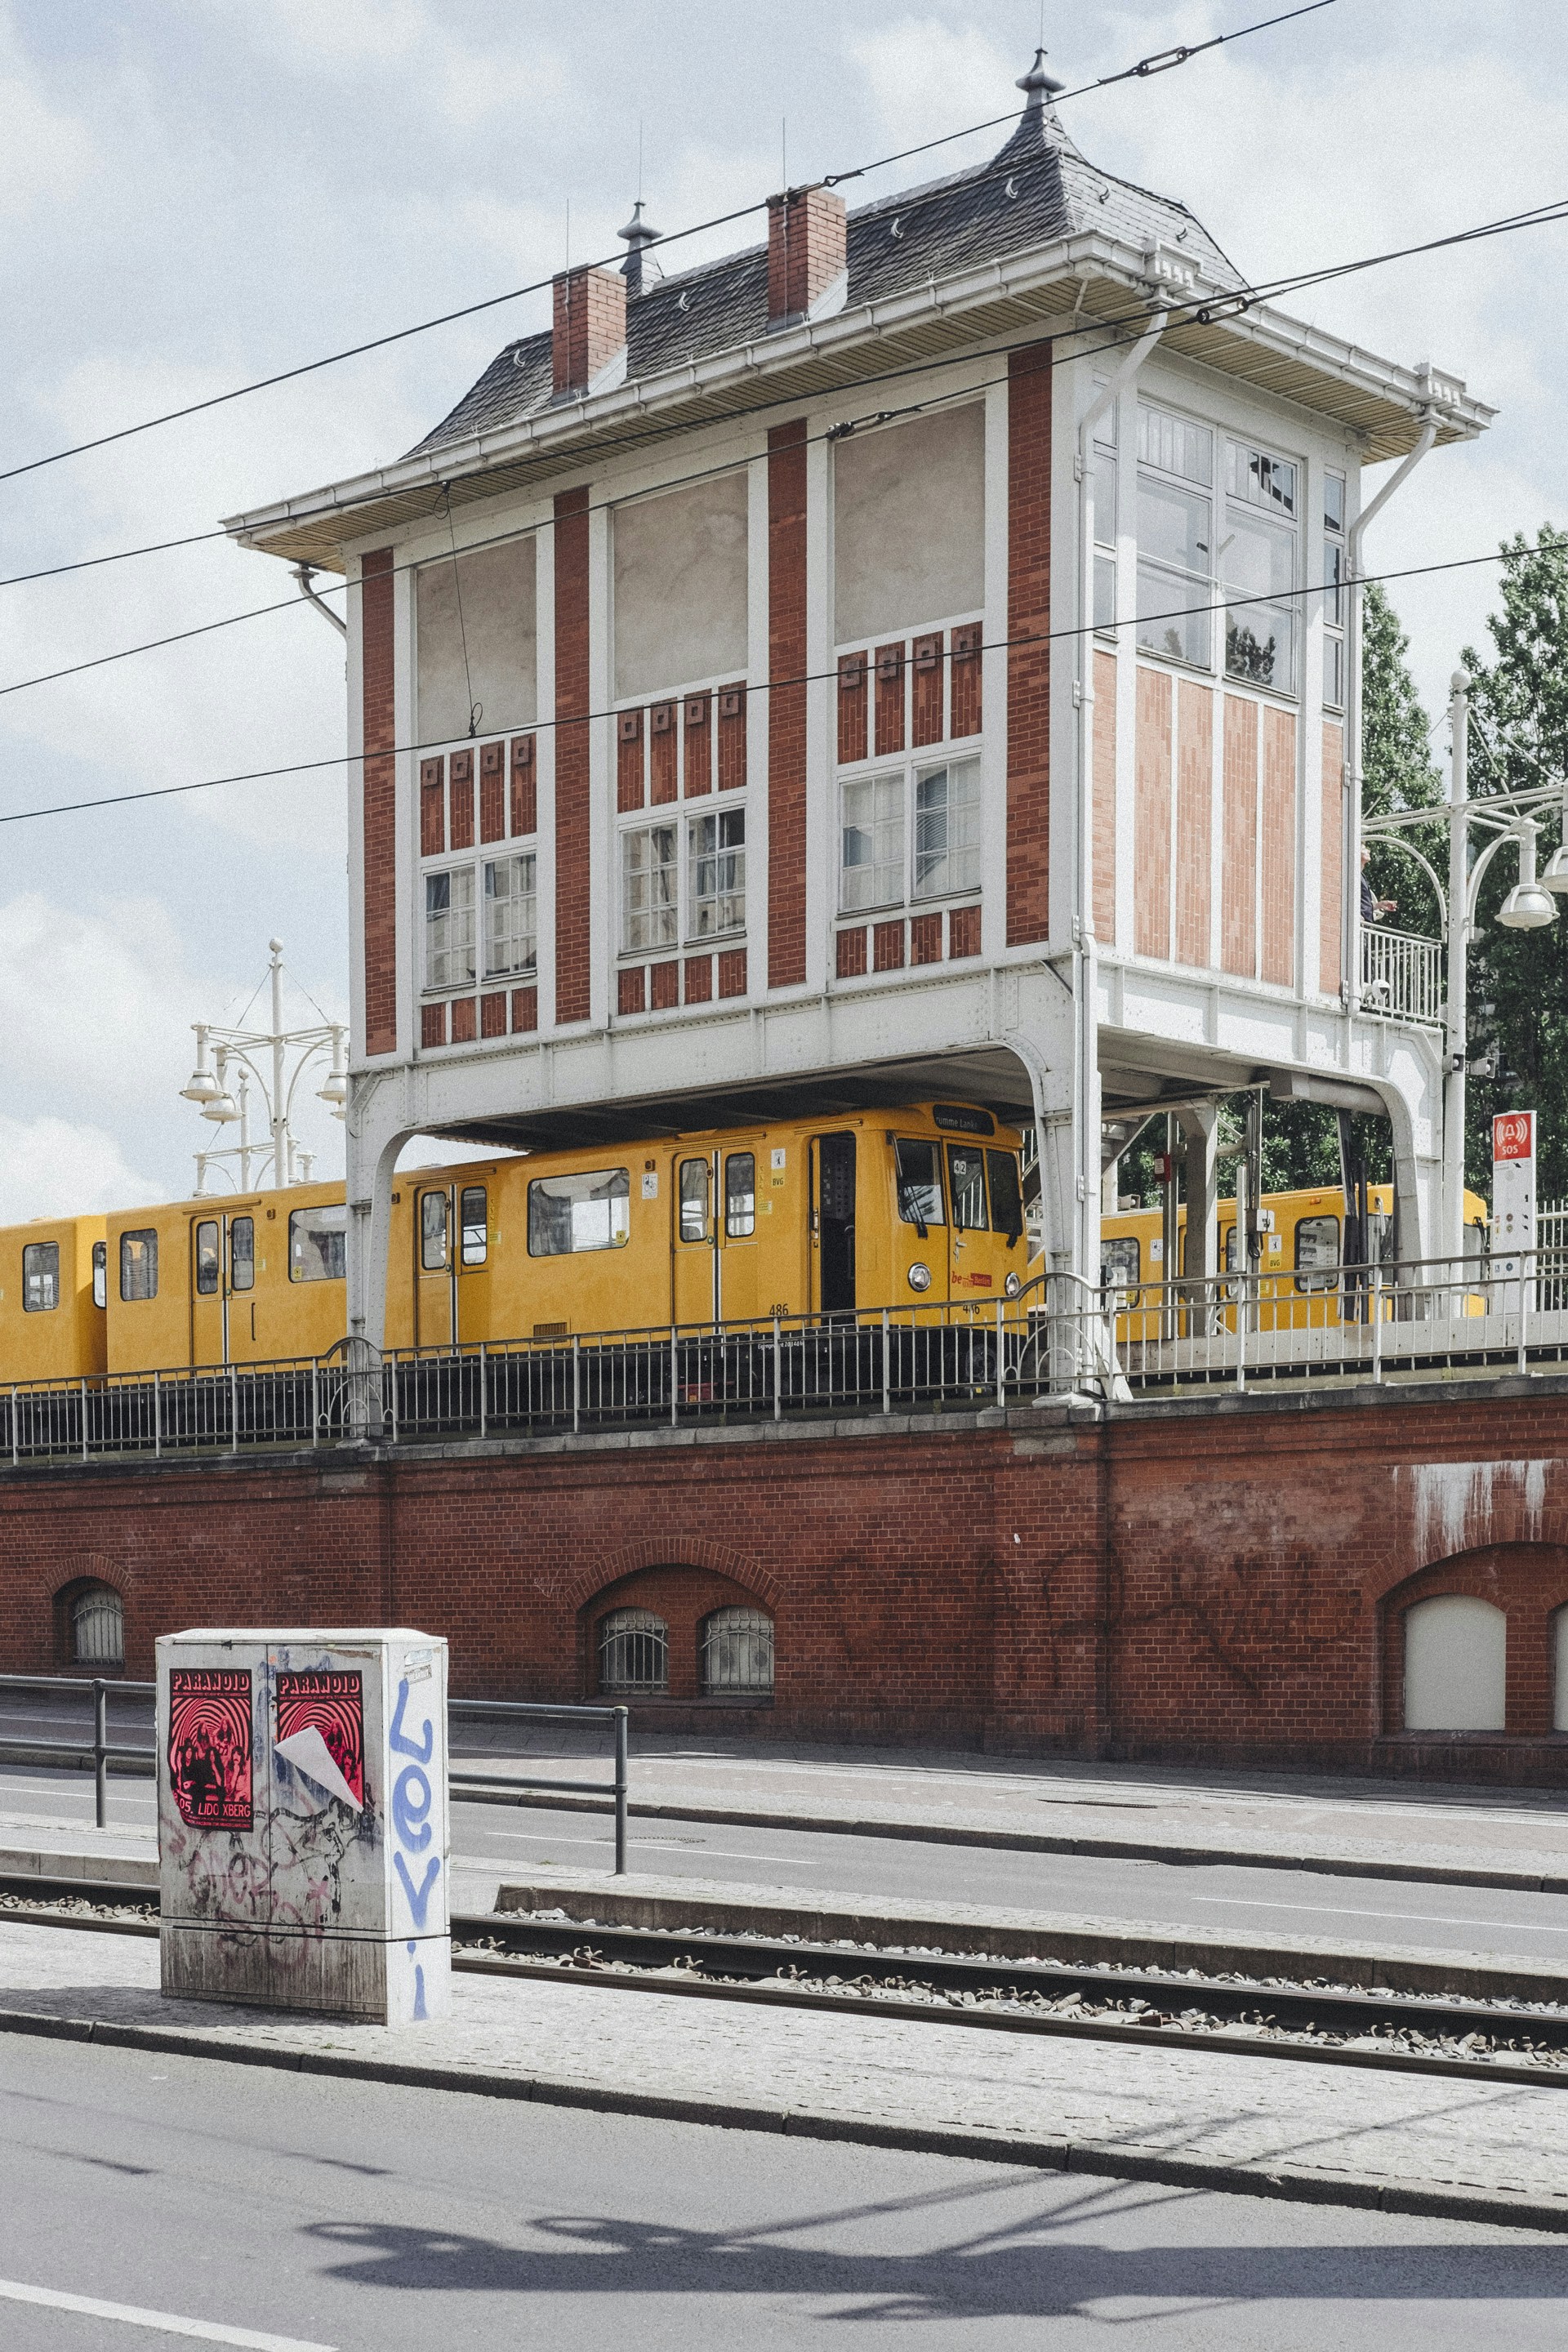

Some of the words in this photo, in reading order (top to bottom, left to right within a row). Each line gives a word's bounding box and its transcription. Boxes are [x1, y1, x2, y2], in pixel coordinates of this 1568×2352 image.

[936, 1116, 959, 1127] rumme
[1502, 1144, 1519, 1156] SOS
[955, 1162, 965, 1173] 42
[773, 1177, 784, 1186] BVG
[951, 1270, 963, 1285] be
[768, 1303, 789, 1316] 486
[172, 1672, 250, 1691] PARANOID
[278, 1674, 360, 1695] PARANOID
[198, 1802, 219, 1815] LIDO
[223, 1804, 251, 1818] XBERG
